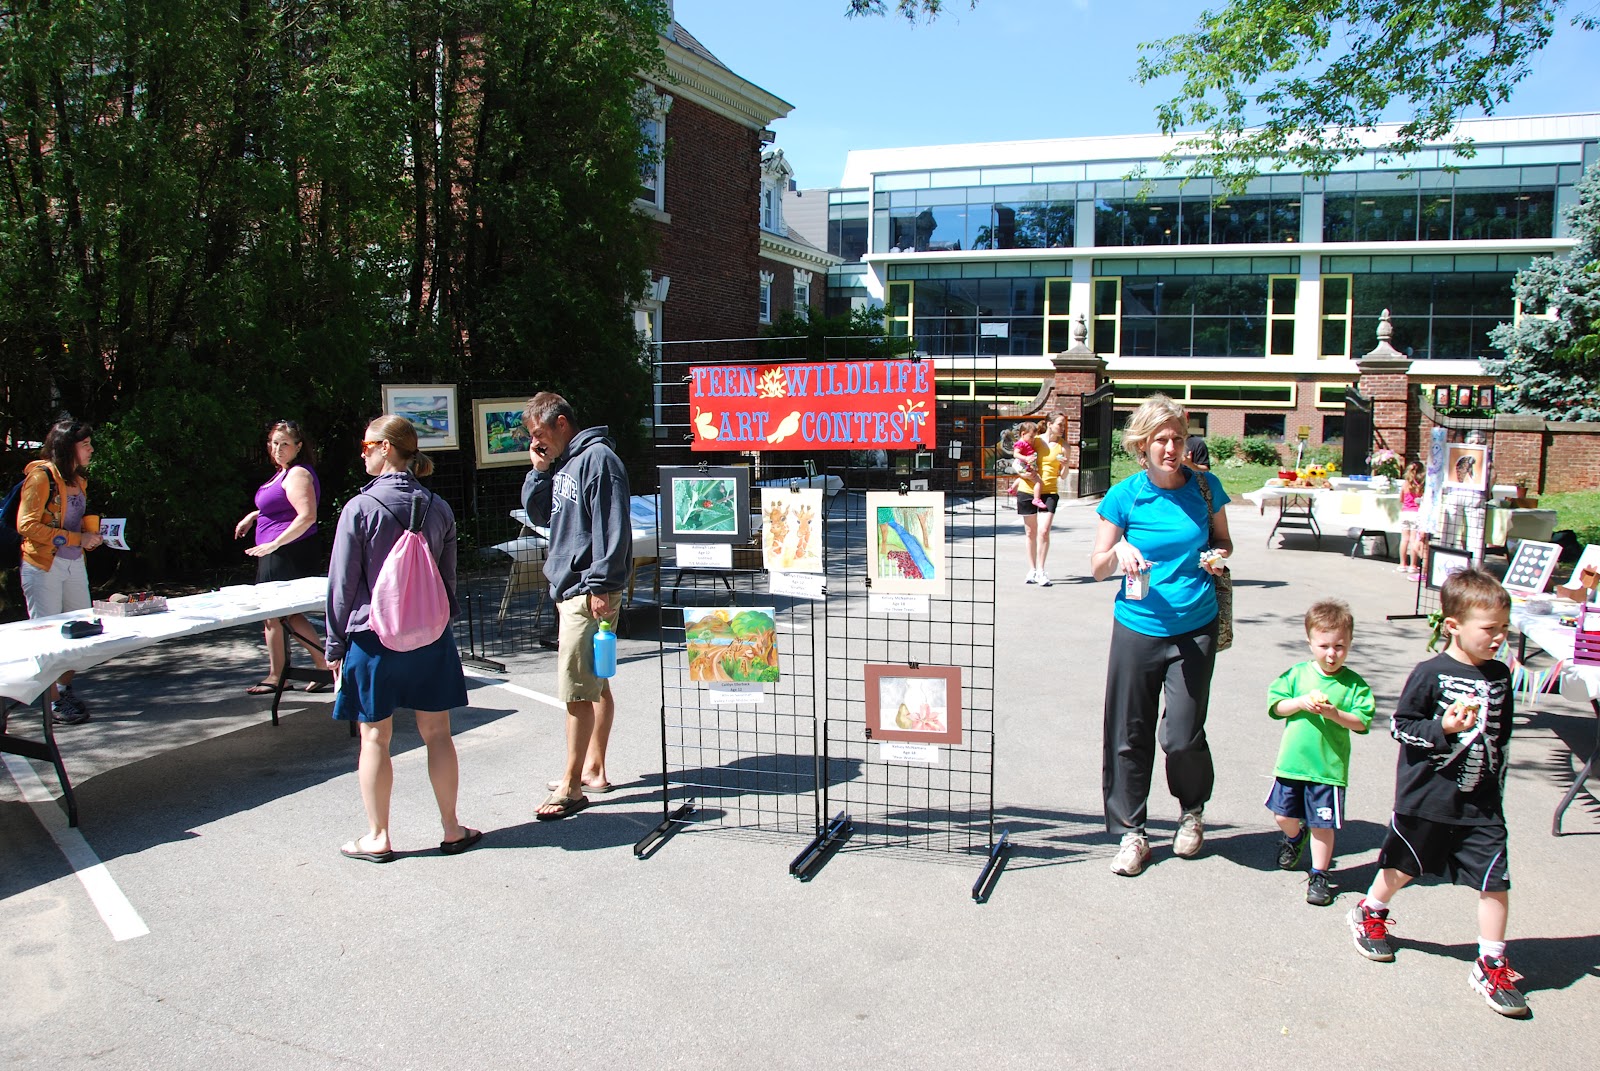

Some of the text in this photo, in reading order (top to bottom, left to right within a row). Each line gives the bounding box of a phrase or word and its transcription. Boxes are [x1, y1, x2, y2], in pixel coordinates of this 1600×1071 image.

[692, 361, 929, 397] TEEN WILDLIFE
[716, 411, 925, 443] ART CONTEST
